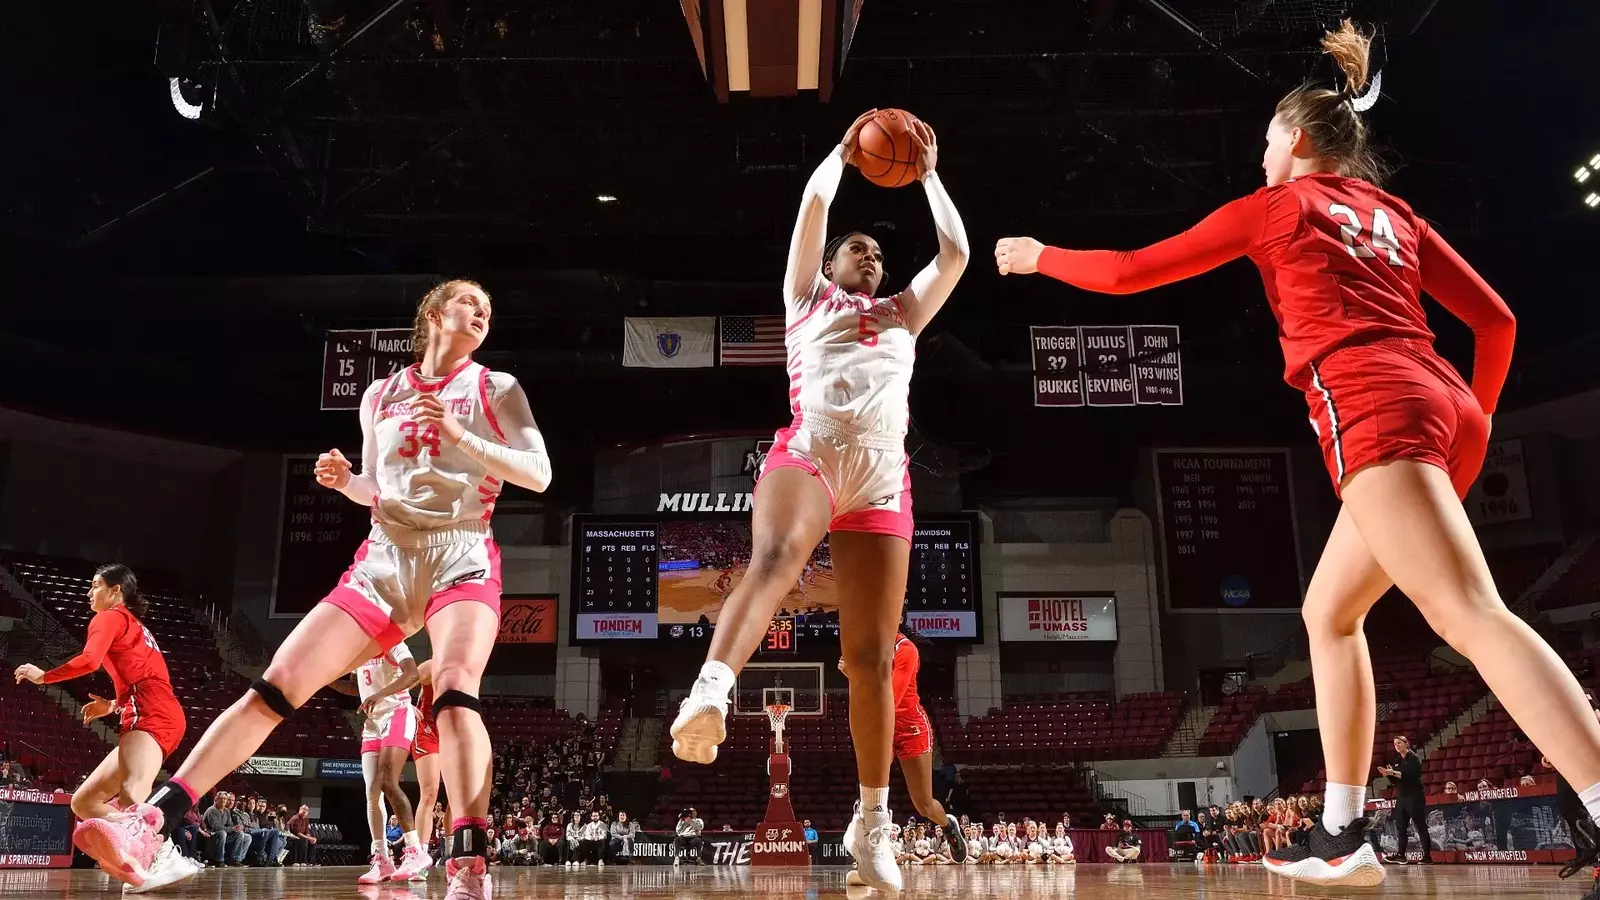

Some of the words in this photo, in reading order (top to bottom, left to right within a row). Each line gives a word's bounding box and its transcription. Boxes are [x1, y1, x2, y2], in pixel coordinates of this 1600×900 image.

[1328, 203, 1404, 267] 24
[858, 315, 879, 347] 5
[1035, 337, 1076, 350] TRIGGER
[1087, 336, 1126, 349] JULIUS
[1144, 336, 1168, 348] JOHN
[340, 359, 354, 376] 15
[1048, 356, 1067, 373] 32
[1138, 367, 1154, 380] 193
[1155, 368, 1179, 380] WINS
[332, 383, 357, 396] ROE
[1039, 380, 1078, 393] BURKE
[1088, 379, 1131, 392] ERVING
[398, 422, 441, 457] 34
[1173, 458, 1200, 470] NCAA
[1204, 458, 1272, 470] TOURNAMENT
[1184, 474, 1200, 482] MEN
[1240, 474, 1272, 483] WOMEN
[1174, 500, 1191, 509] 1993
[1480, 498, 1518, 518] 1996
[1176, 530, 1194, 540] 1997
[1201, 530, 1220, 540] 1998
[1177, 545, 1196, 554] 2014
[1224, 590, 1250, 598] NCAA
[1042, 600, 1087, 621] HOTEL
[501, 604, 552, 634] Cola
[770, 621, 792, 630] 5:35
[911, 618, 960, 631] TANDEM
[593, 620, 642, 634] TANDEM
[689, 627, 703, 637] 13
[1043, 623, 1088, 632] UMASS
[768, 632, 790, 649] 30
[363, 670, 372, 686] 3
[12, 790, 54, 803] SPRINGFIELD
[1465, 792, 1478, 801] MGM
[1480, 788, 1518, 800] SPRINGFIELD
[32, 836, 65, 853] England
[633, 843, 666, 857] STUDENT
[754, 841, 806, 853] DUNKIN'
[823, 844, 832, 857] OF
[8, 855, 50, 865] SPRINGFIELD
[711, 842, 754, 866] THE
[1473, 851, 1487, 860] MGM
[1488, 851, 1527, 860] SPRINGFIELD
